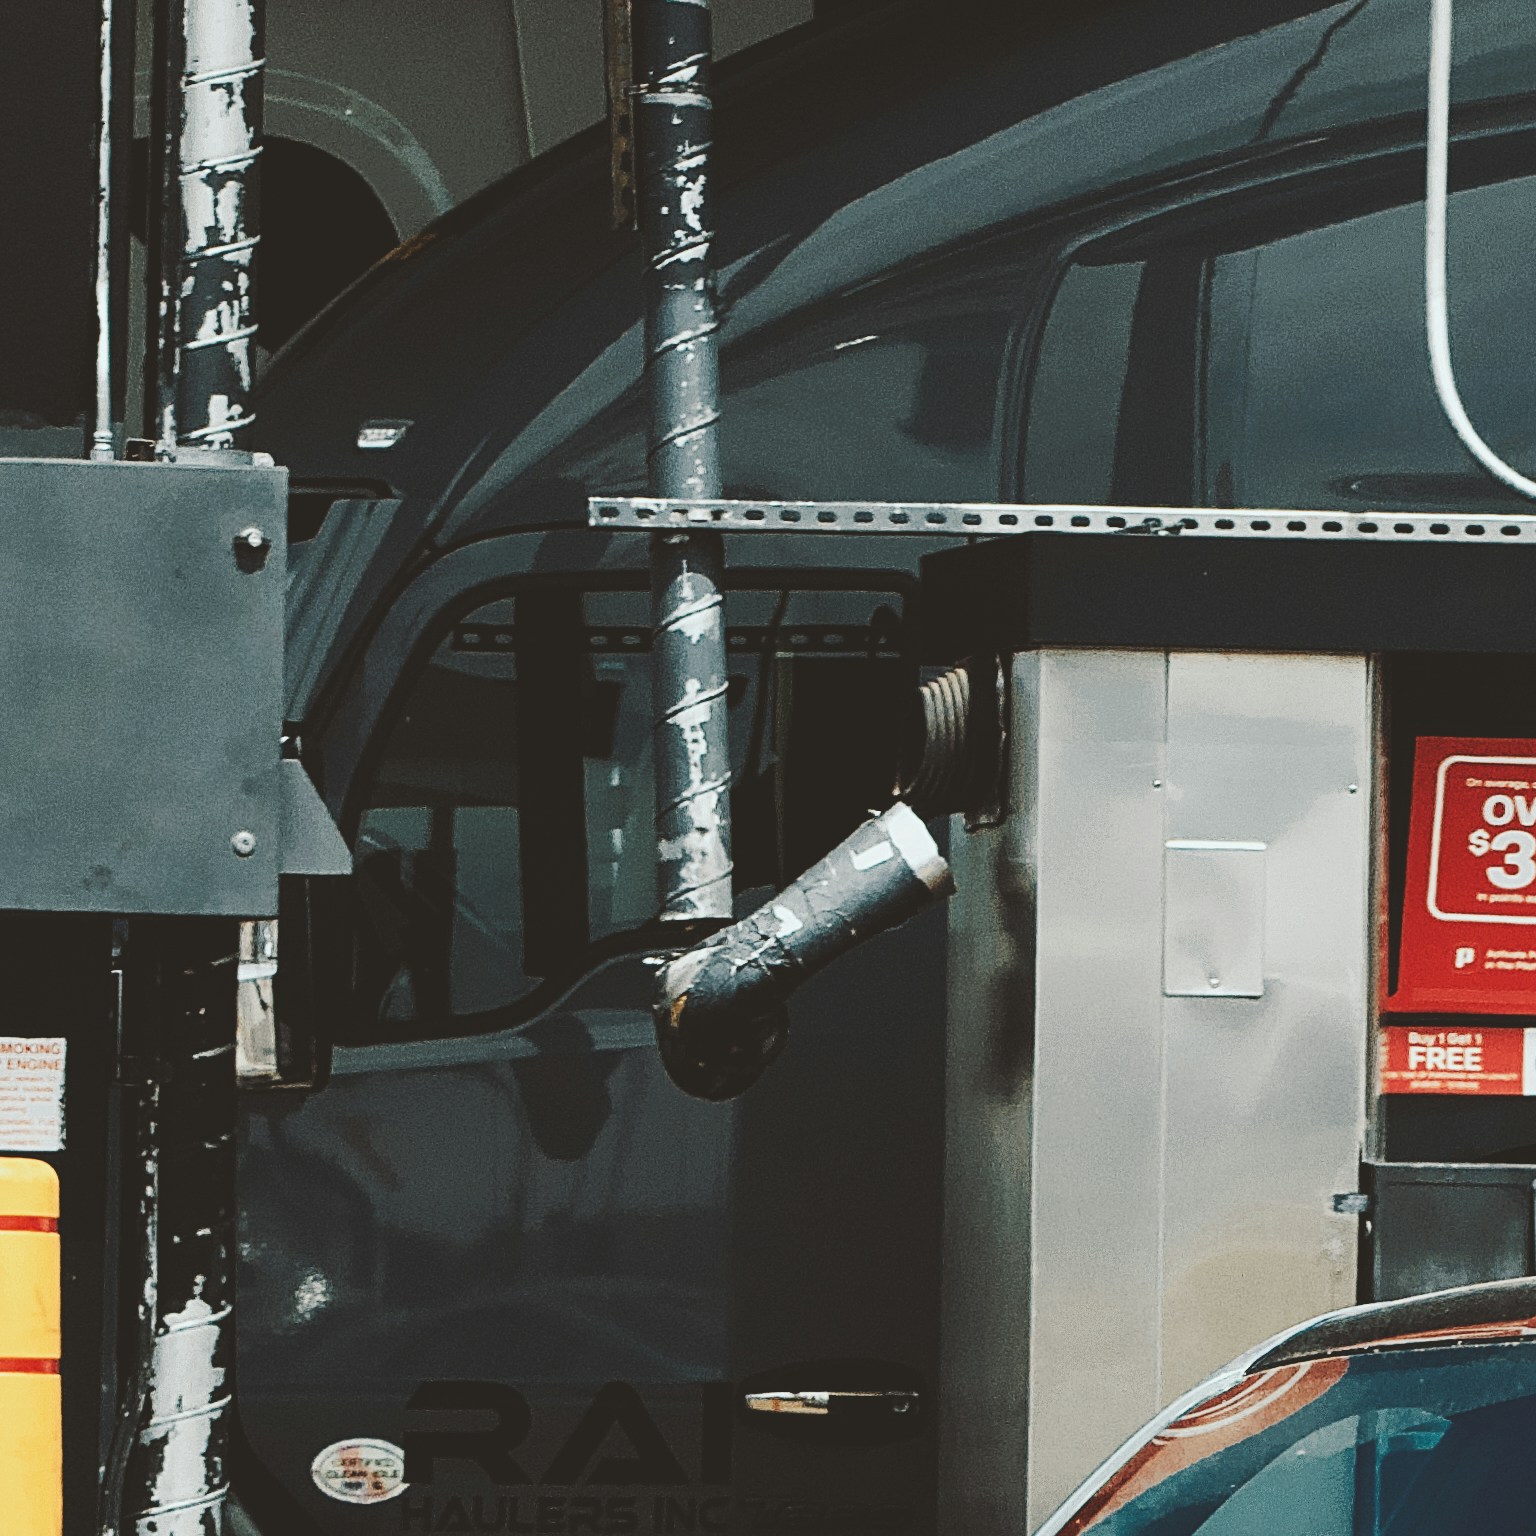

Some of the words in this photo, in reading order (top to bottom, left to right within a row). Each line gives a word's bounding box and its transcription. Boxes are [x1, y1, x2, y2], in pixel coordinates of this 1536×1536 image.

[1408, 1045, 1484, 1072] FREE
[400, 1495, 639, 1534] HAULERS
[653, 1495, 731, 1534] INC
